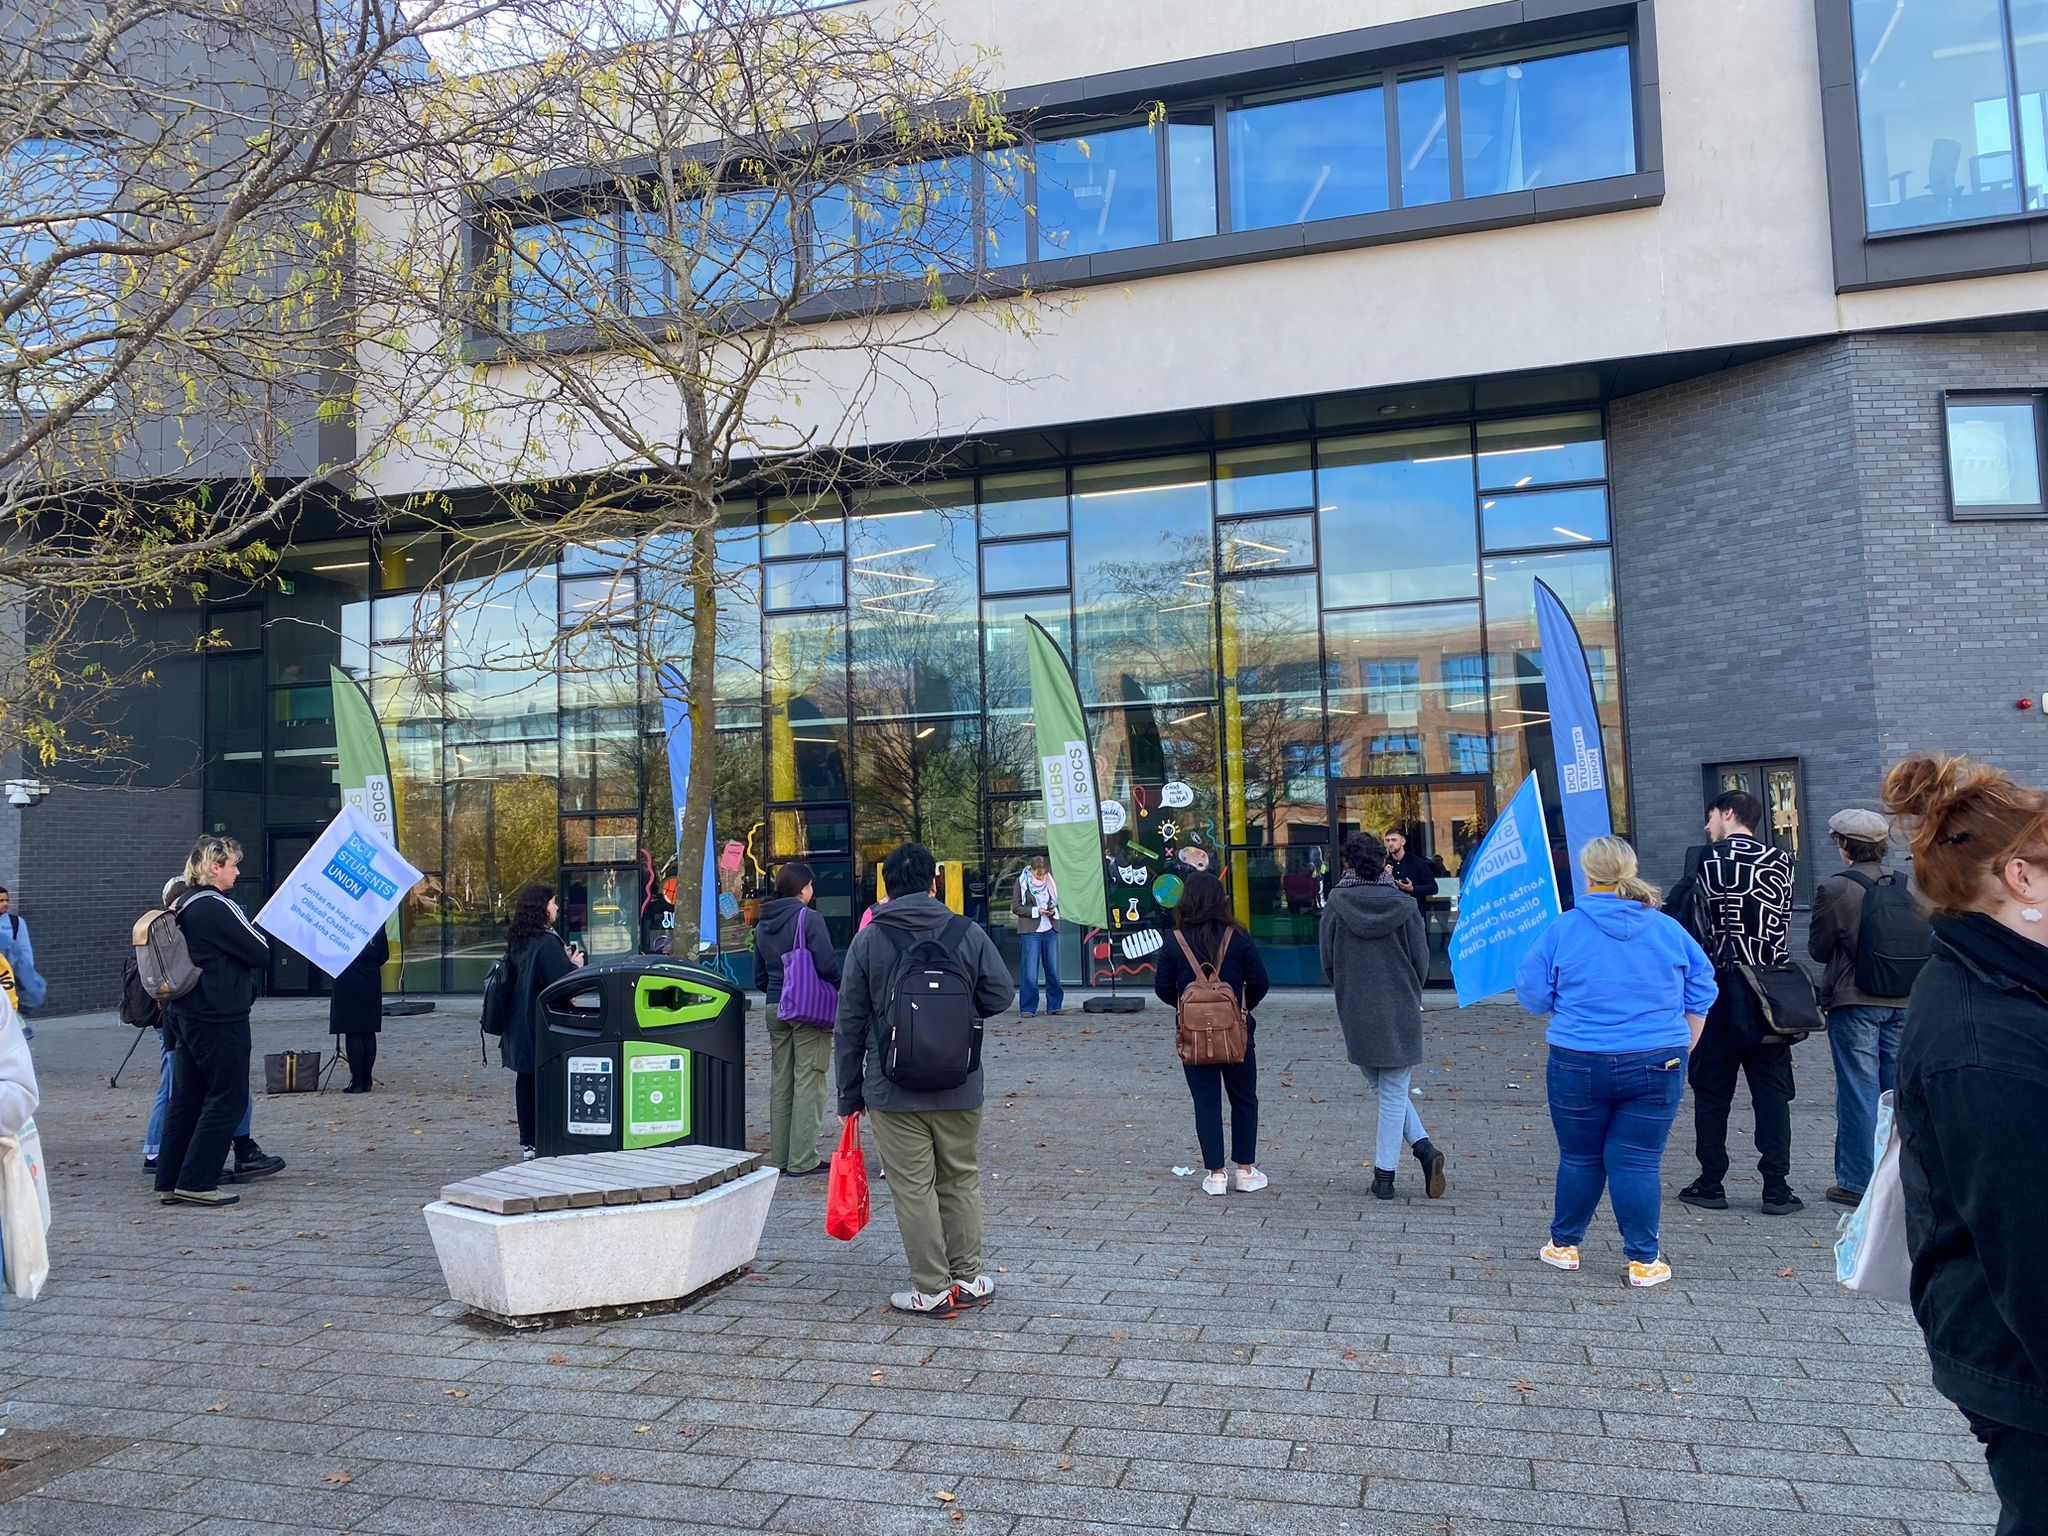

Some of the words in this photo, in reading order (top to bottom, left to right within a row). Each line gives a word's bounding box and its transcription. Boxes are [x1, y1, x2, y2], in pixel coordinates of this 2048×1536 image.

[1069, 748, 1088, 794] SOCS
[1566, 766, 1577, 790] DCU
[1588, 751, 1600, 786] UNION
[371, 781, 387, 822] SOCS
[1048, 762, 1066, 819] CLUBS
[1076, 803, 1090, 816] &
[349, 836, 373, 859] DCU
[328, 864, 362, 895] UNION
[338, 850, 395, 896] STUDENTS'
[300, 883, 327, 904] Aontas
[326, 902, 336, 911] na
[335, 908, 351, 923] Mac
[290, 904, 314, 924] Bhaile
[329, 934, 351, 952] Cliath
[326, 916, 356, 941] Chathair
